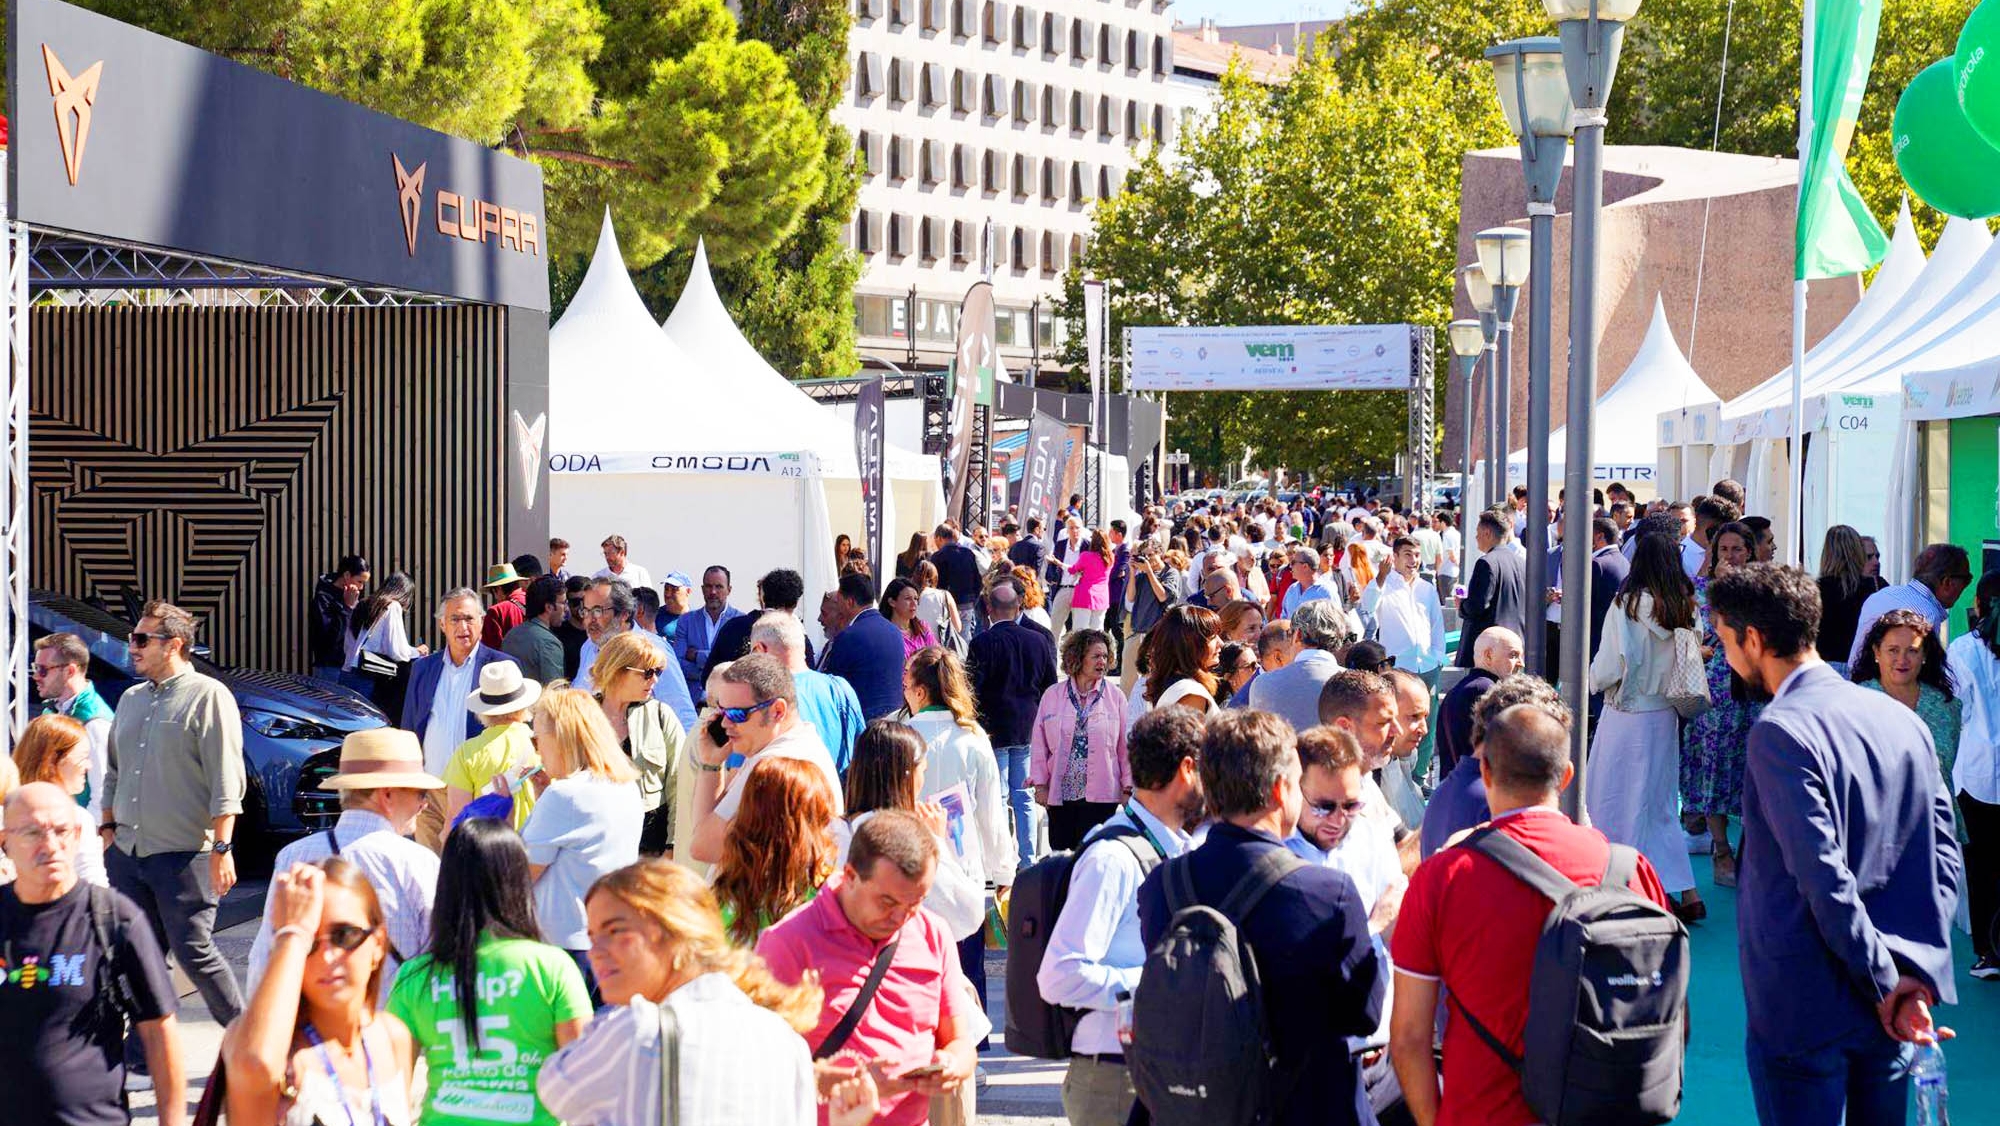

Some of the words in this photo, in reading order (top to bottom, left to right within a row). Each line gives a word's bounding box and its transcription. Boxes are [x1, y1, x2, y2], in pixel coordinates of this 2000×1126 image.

[436, 187, 538, 256] CUPRA
[1245, 343, 1295, 357] vem
[1842, 396, 1873, 406] vem
[1839, 415, 1868, 430] C04
[549, 454, 602, 472] ODA
[781, 466, 801, 477] A12
[1593, 466, 1657, 480] CITR
[1607, 973, 1649, 986] wallbox
[431, 969, 523, 1006] Hlp?
